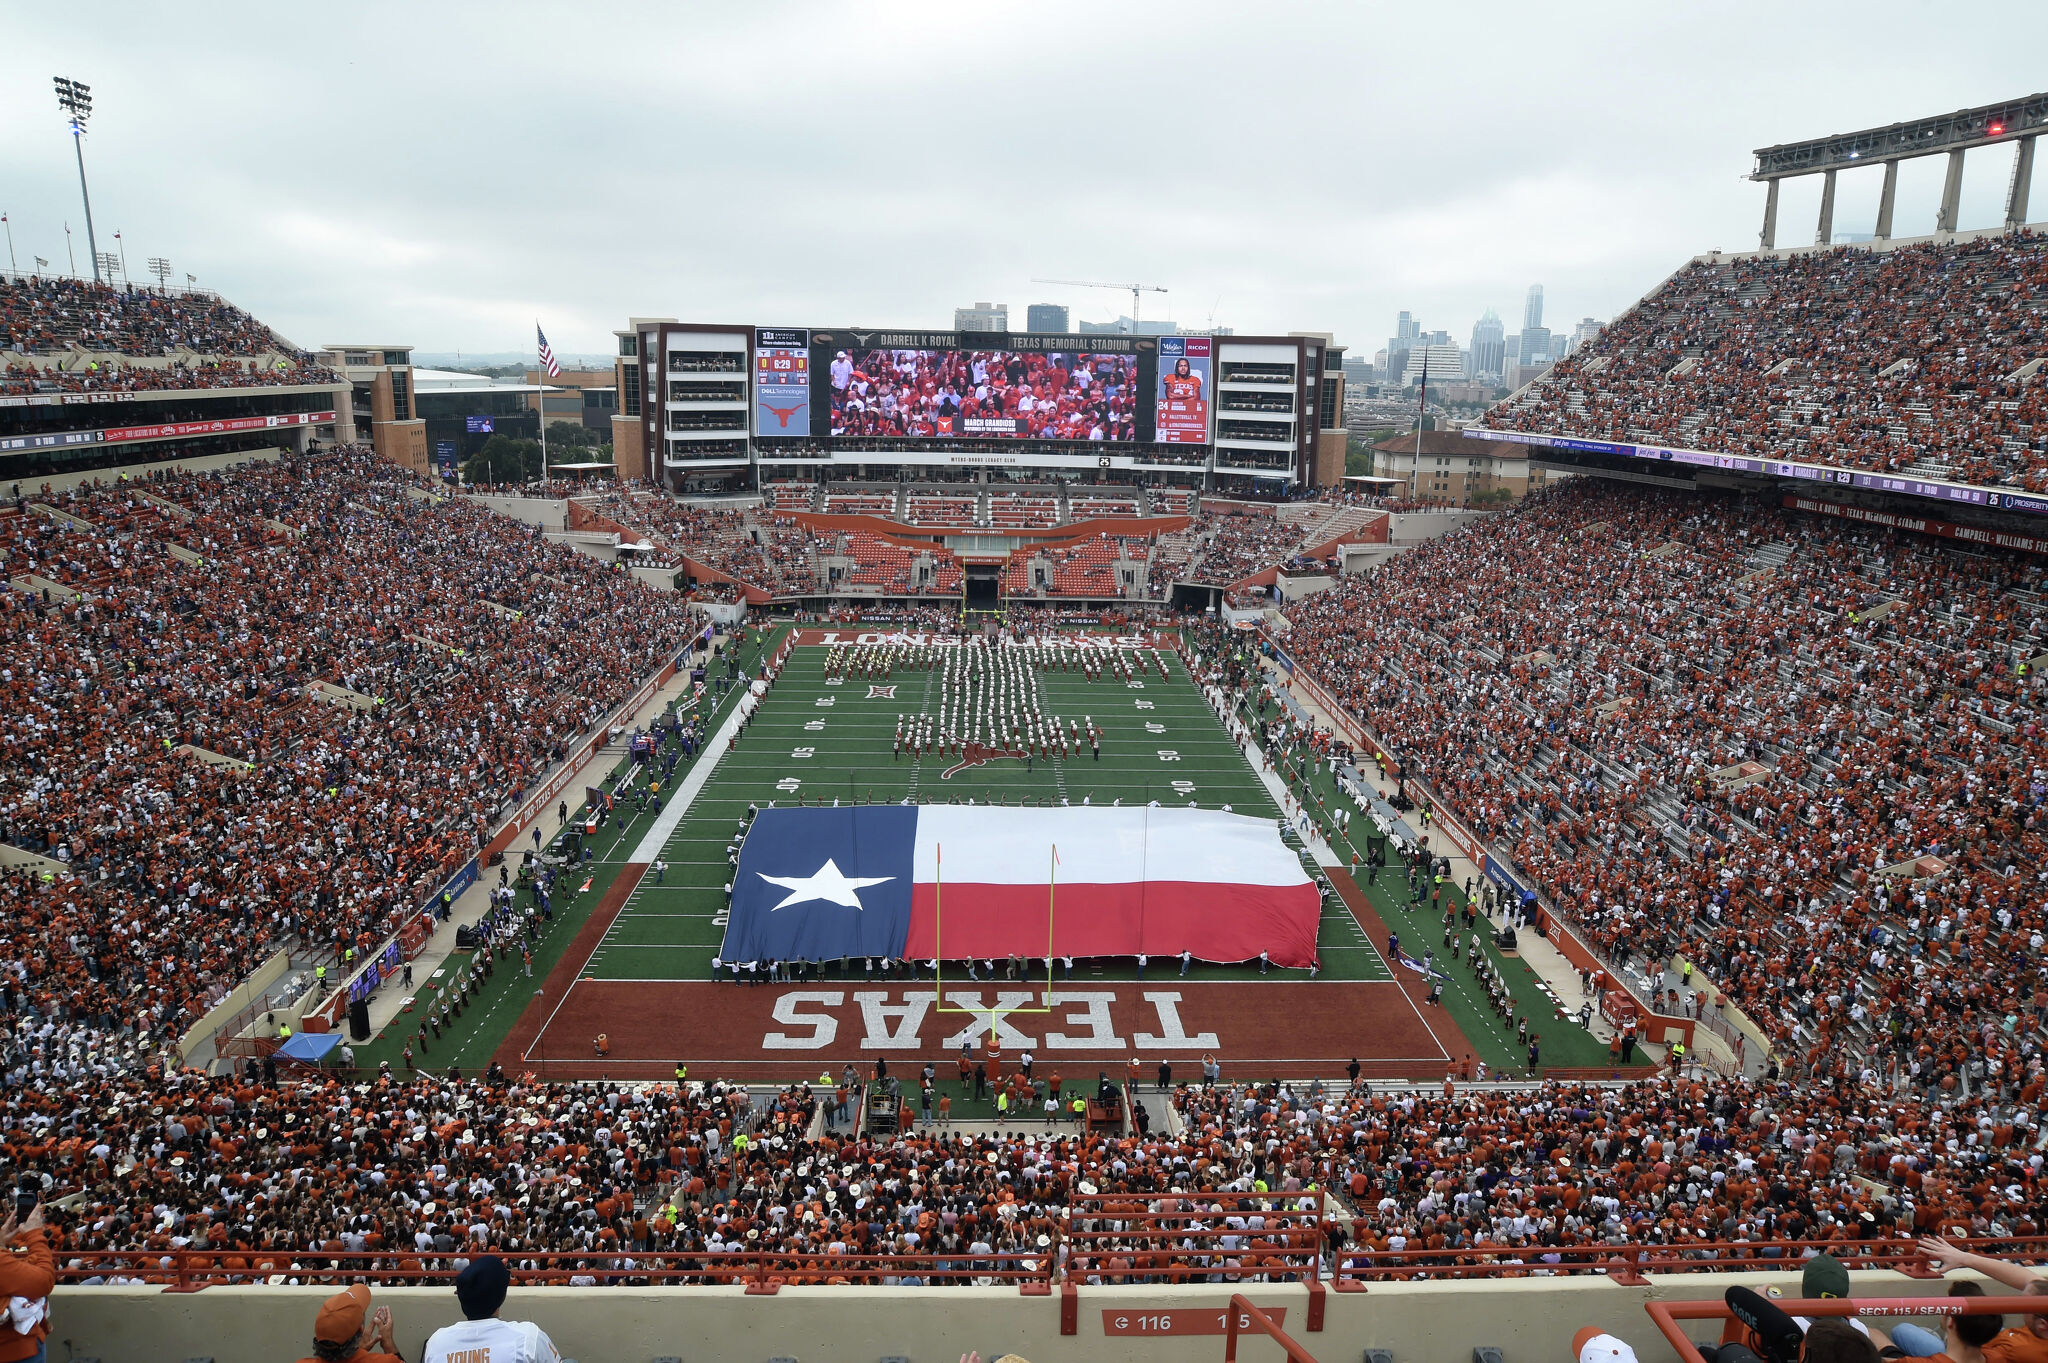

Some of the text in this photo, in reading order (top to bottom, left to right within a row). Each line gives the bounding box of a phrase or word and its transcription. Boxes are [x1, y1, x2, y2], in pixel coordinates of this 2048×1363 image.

[880, 334, 1130, 351] DARRELL K ROYAL TEXAS MEMORIAL STADIUM
[762, 358, 767, 368] 0
[774, 359, 791, 370] 6:29
[798, 359, 804, 369] 0
[1158, 401, 1169, 410] 24
[964, 418, 1016, 427] MARCH GRANDIOSO
[97, 431, 104, 441] 25
[1100, 457, 1110, 467] 25
[1795, 467, 1811, 478] KANSAS
[1837, 472, 1850, 483] 6:29
[1863, 476, 1872, 485] 1ST
[1989, 493, 1999, 505] 25
[2014, 499, 2048, 511] PROSPERIT
[1796, 499, 1818, 511] DARRELL
[1824, 504, 1841, 515] ROYAL
[1846, 507, 1864, 520] TEXAS
[1865, 511, 1896, 526] MEMORIAL
[1897, 517, 1926, 531] STADIUM
[1954, 526, 1990, 543] CAMPBELL
[1995, 533, 2034, 550] WILLIAMS
[791, 747, 815, 758] 50
[1157, 750, 1181, 761] 50
[775, 777, 801, 790] 40
[1171, 780, 1196, 793] 40
[1442, 815, 1472, 853] LONGHORNS
[1490, 866, 1509, 890] American
[450, 879, 466, 897] Airlines
[762, 991, 1221, 1050] TEXAS
[598, 1132, 609, 1141] 50
[1732, 1302, 1758, 1329] RØDE
[1858, 1306, 1889, 1317] SECT.
[1893, 1306, 1911, 1316] 115
[1920, 1305, 1948, 1316] SEAT
[1951, 1305, 1963, 1315] 31
[1137, 1315, 1172, 1331] 116
[1217, 1314, 1250, 1329] 15
[446, 1347, 491, 1363] YOUNG
